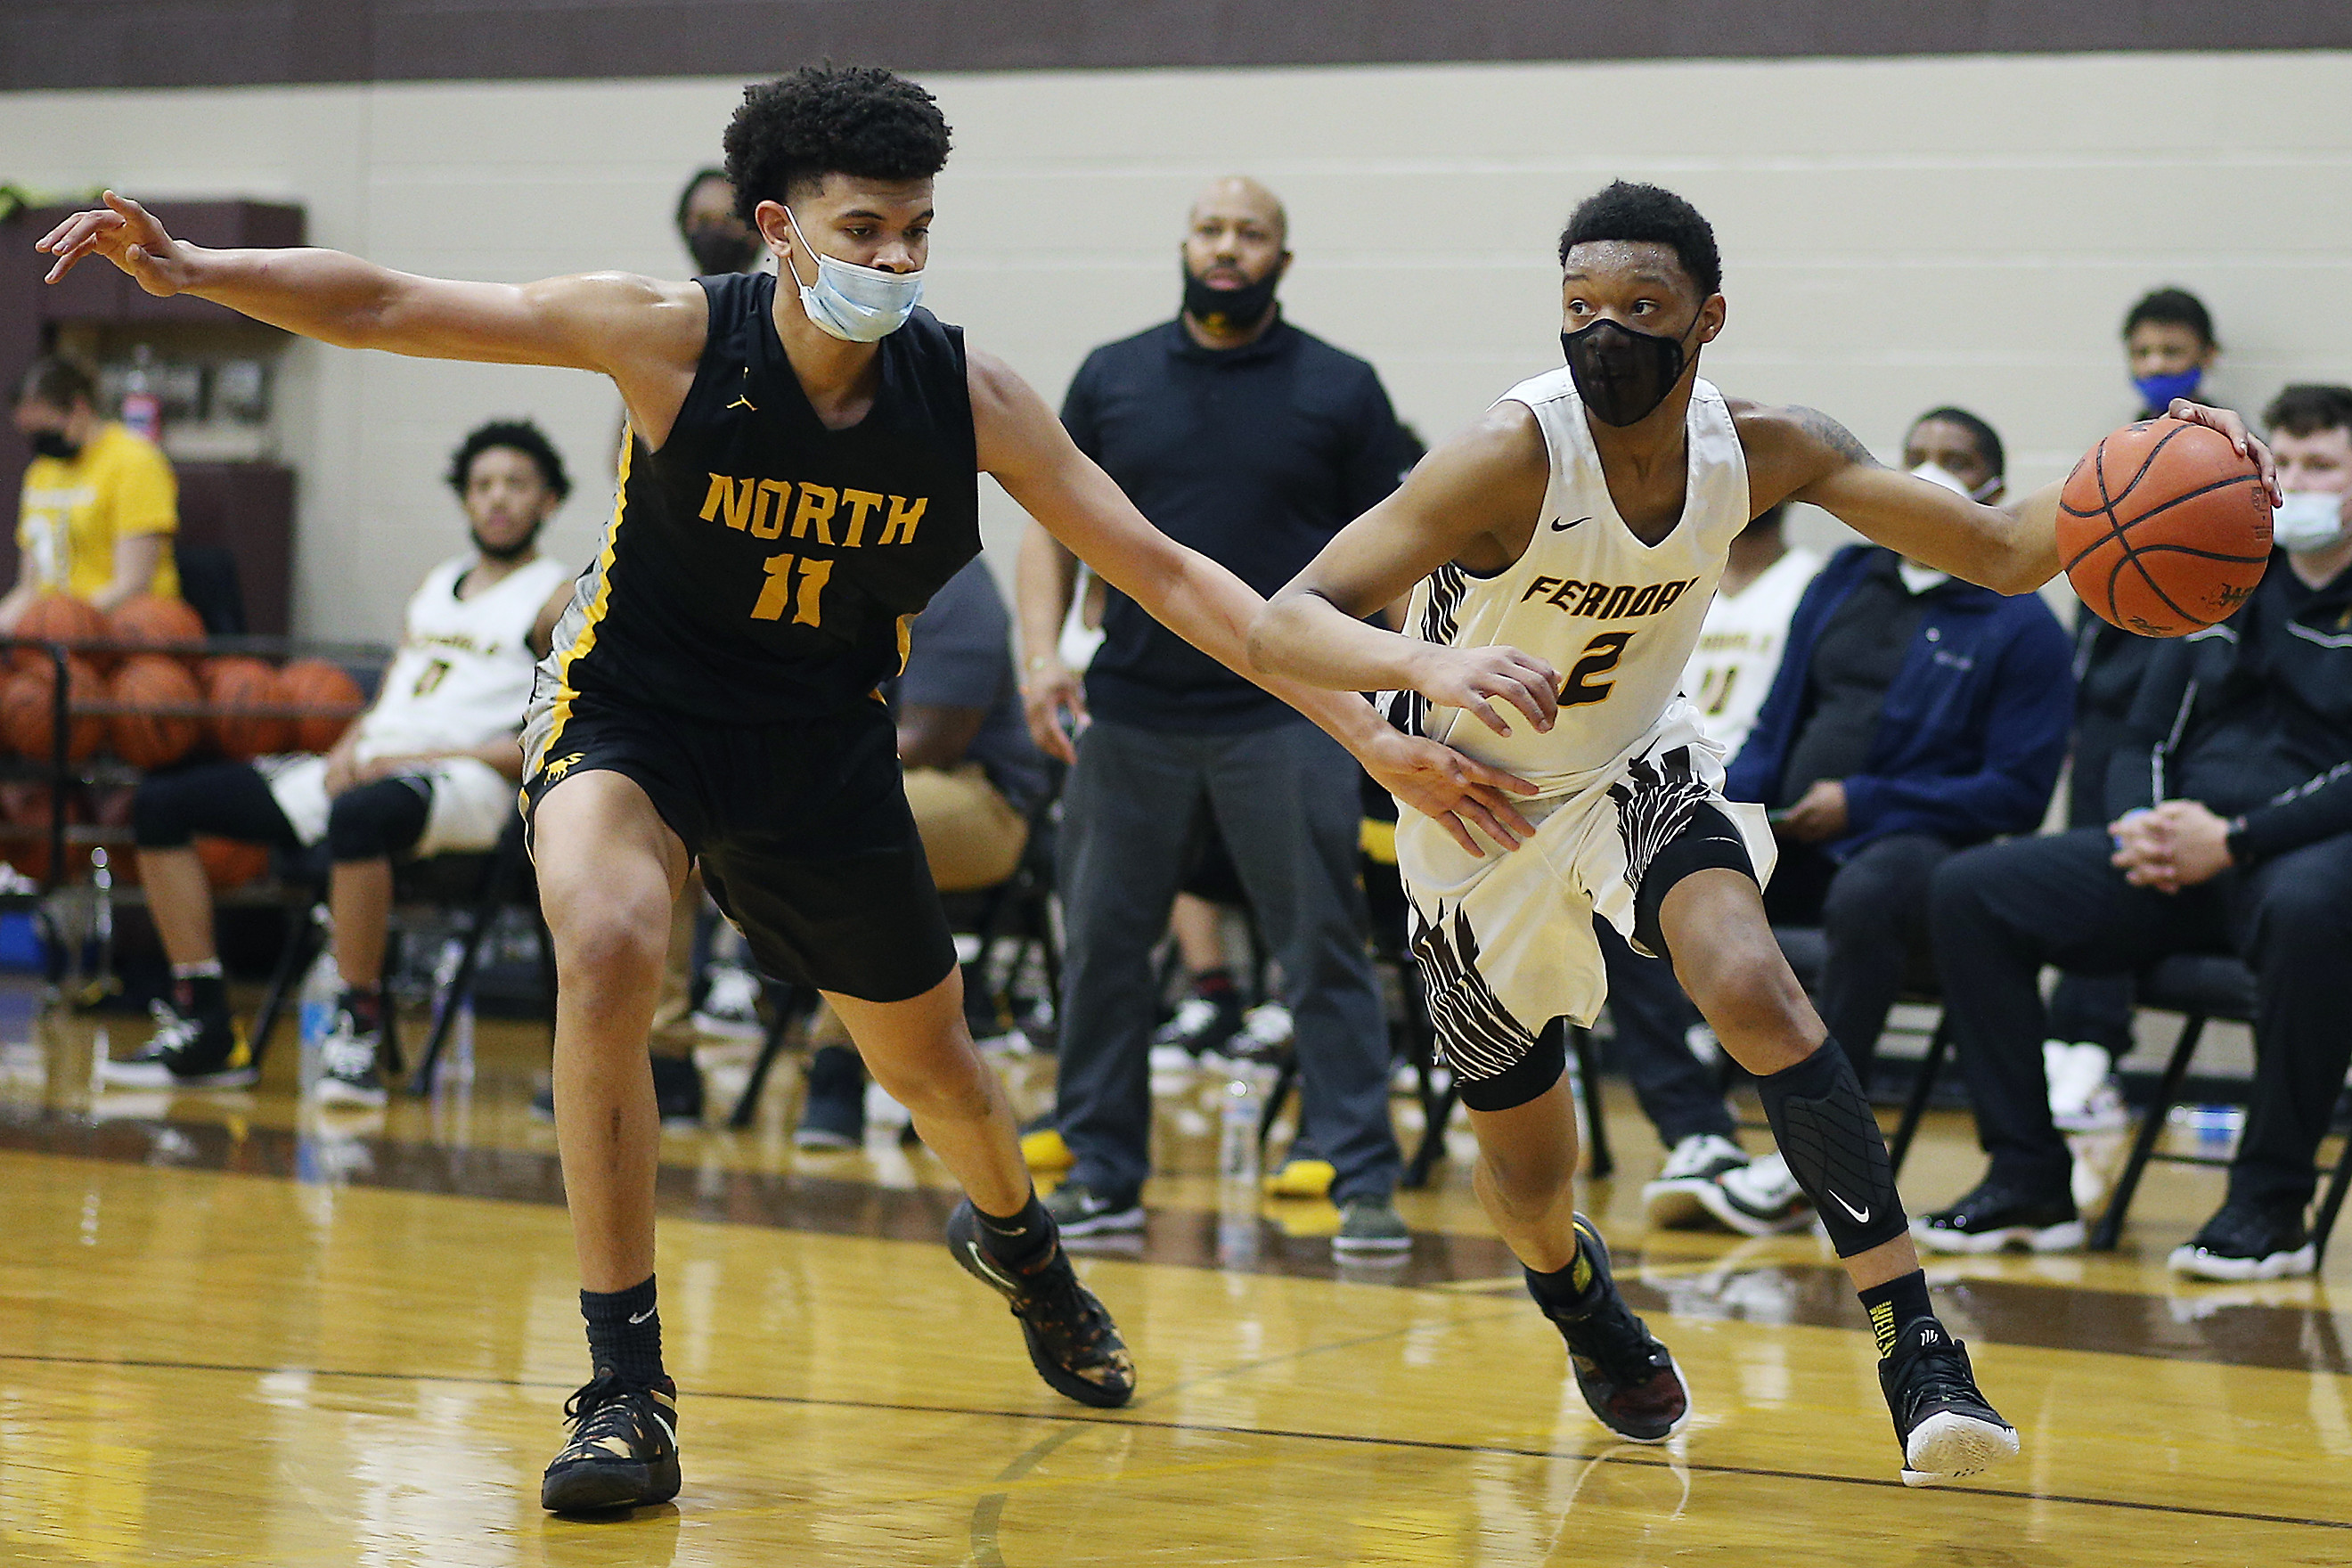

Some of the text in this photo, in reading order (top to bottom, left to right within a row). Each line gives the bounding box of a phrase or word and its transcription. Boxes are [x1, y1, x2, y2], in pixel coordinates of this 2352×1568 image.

[698, 472, 928, 548] NORTH
[750, 553, 835, 629] 11
[1521, 575, 1700, 620] FERNDA
[1556, 630, 1637, 709] 2
